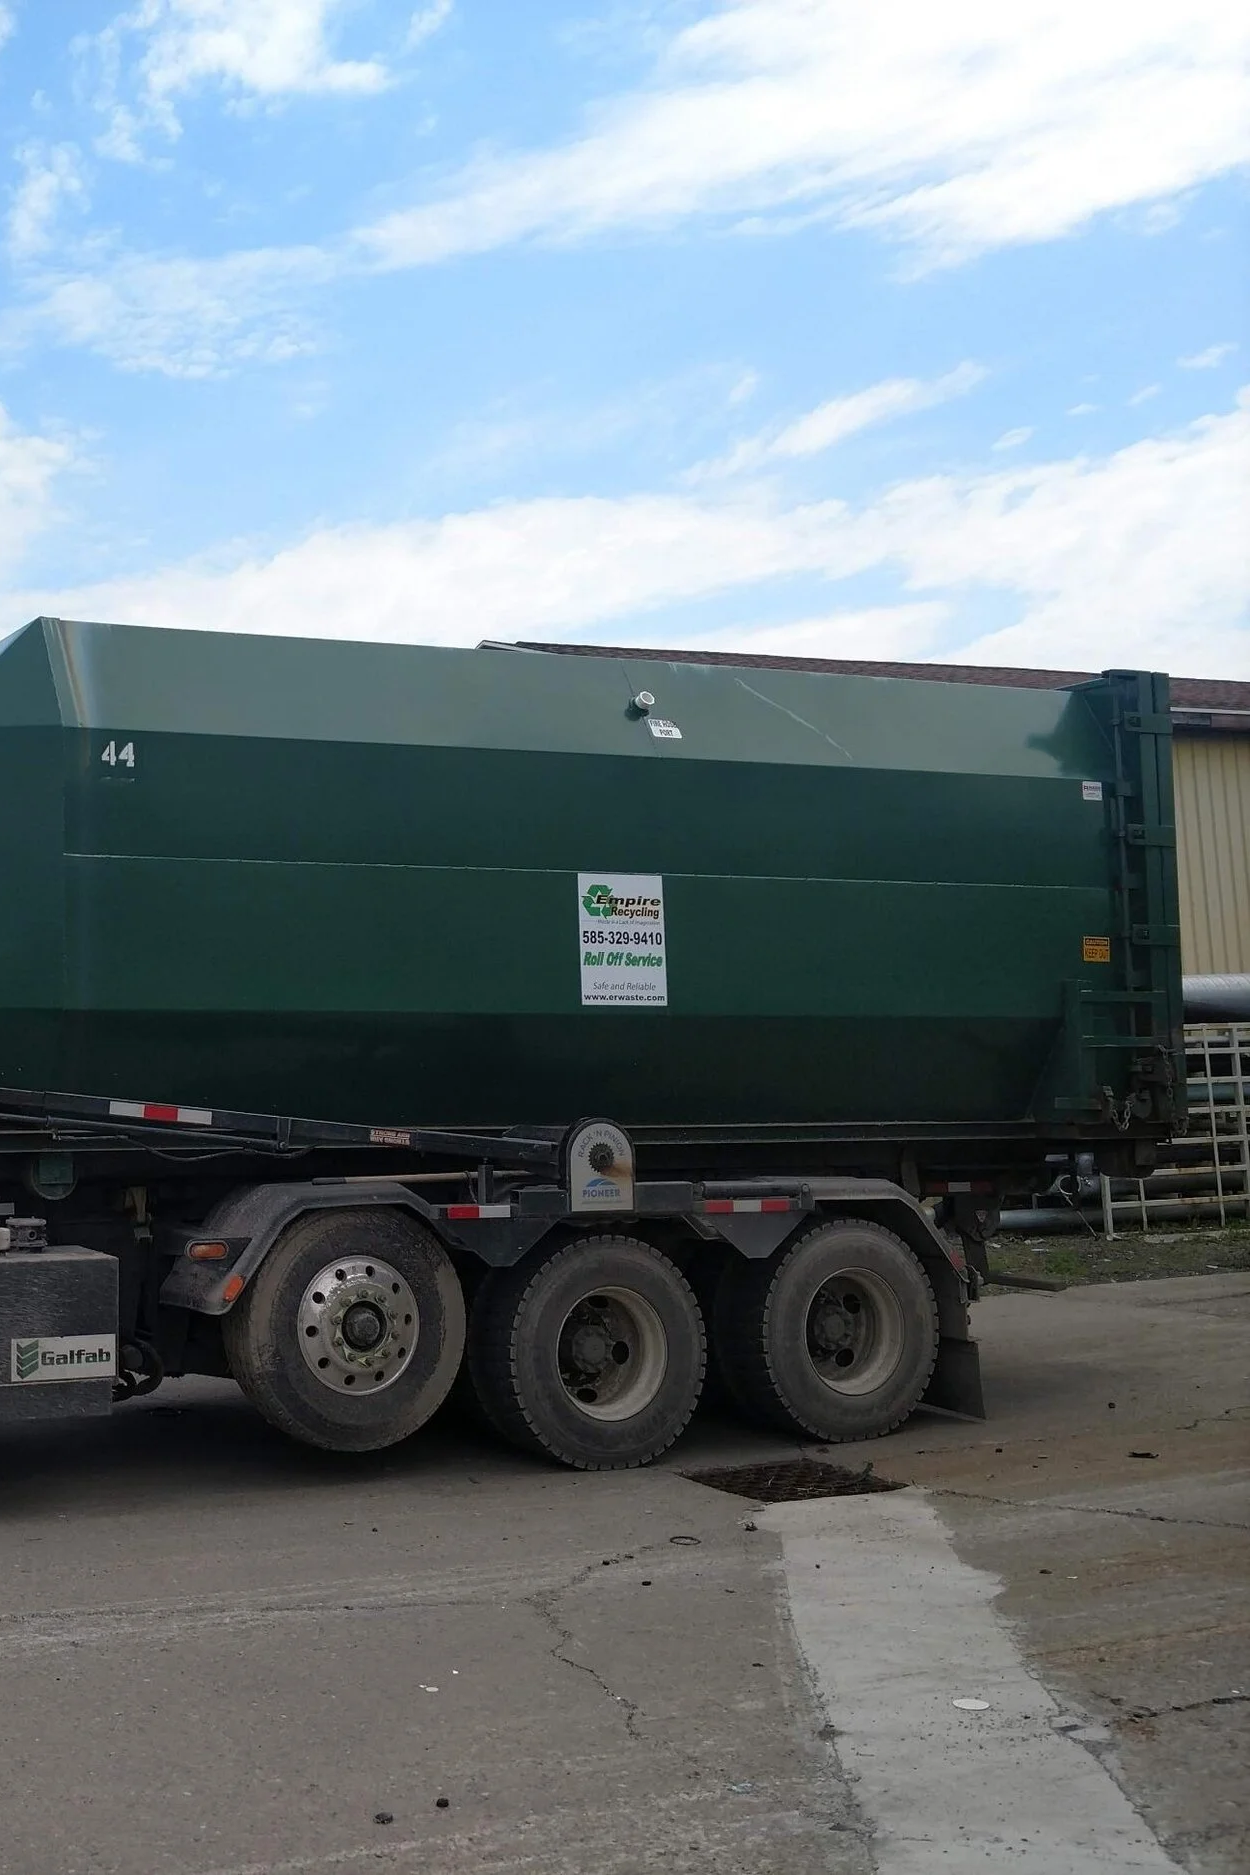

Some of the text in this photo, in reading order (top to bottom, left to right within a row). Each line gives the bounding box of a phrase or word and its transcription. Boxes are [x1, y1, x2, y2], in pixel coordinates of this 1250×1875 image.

[101, 741, 135, 767] 44
[596, 895, 661, 907] Empire
[611, 907, 659, 919] Recycling
[583, 931, 662, 945] 585-329-9410
[583, 952, 663, 967] Roll Off Service
[593, 981, 656, 991] Safe and Reliable
[578, 1132, 593, 1158] RACK
[603, 1130, 626, 1157] PINION
[582, 1189, 621, 1197] PIONEER
[41, 1348, 111, 1366] Galfab
